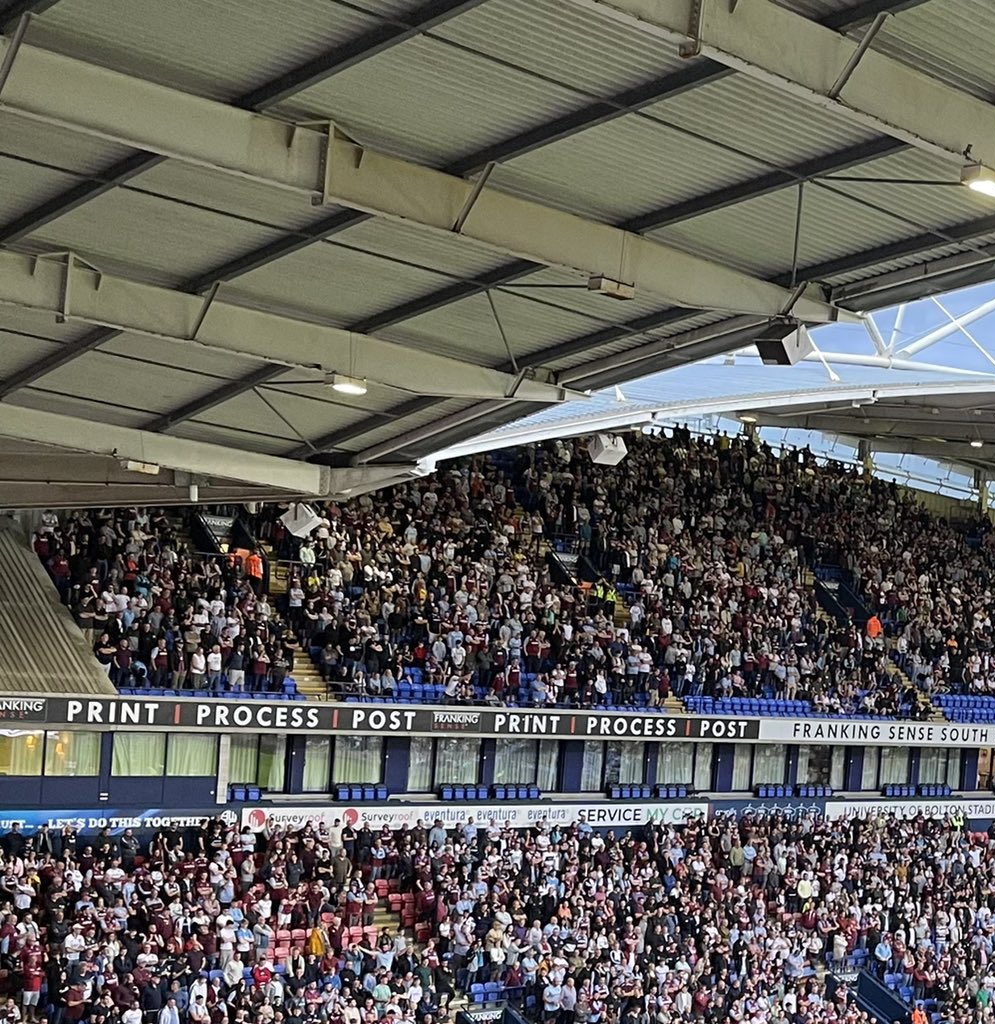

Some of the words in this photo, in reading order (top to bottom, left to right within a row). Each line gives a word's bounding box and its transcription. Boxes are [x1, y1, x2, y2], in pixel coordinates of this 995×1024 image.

[67, 701, 159, 724] PRINT
[197, 704, 319, 728] PROCESS
[353, 711, 415, 731] POST
[434, 713, 479, 724] FRANKING
[494, 713, 561, 735] PRINT
[587, 716, 676, 737] PROCESS
[701, 720, 748, 738] POST
[793, 723, 880, 740] FRANKING
[889, 725, 934, 741] SENSE
[940, 726, 988, 743] SOUTH
[88, 818, 107, 828] DO
[109, 816, 143, 828] THIS
[361, 810, 414, 824] Surveyroof
[577, 808, 642, 822] SERVICE
[647, 808, 669, 820] MY
